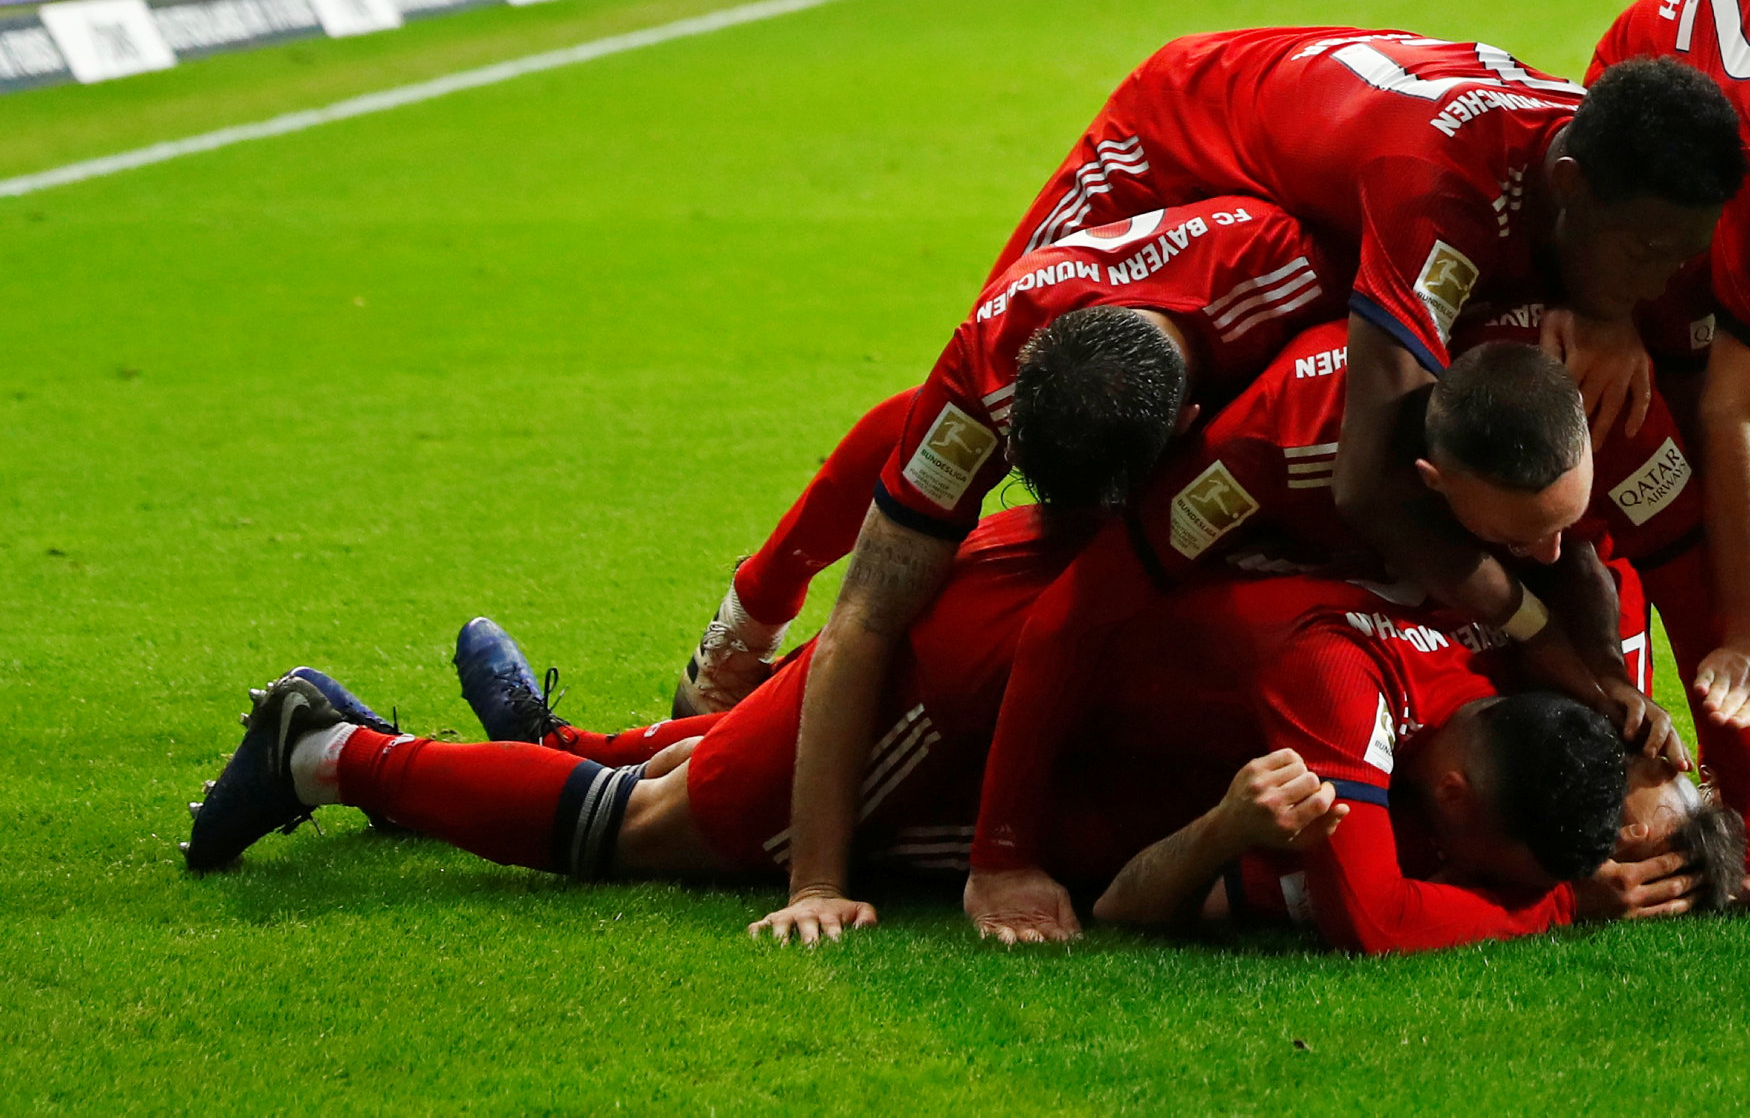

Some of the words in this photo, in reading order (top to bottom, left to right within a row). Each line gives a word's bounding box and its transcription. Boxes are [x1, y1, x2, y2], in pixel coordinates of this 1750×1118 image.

[1212, 208, 1252, 225] FC
[1107, 217, 1208, 286] BAYERN
[920, 449, 967, 483] BUNDESLIGA
[1619, 448, 1681, 507] QATAR
[1647, 461, 1686, 506] AIRWAYS
